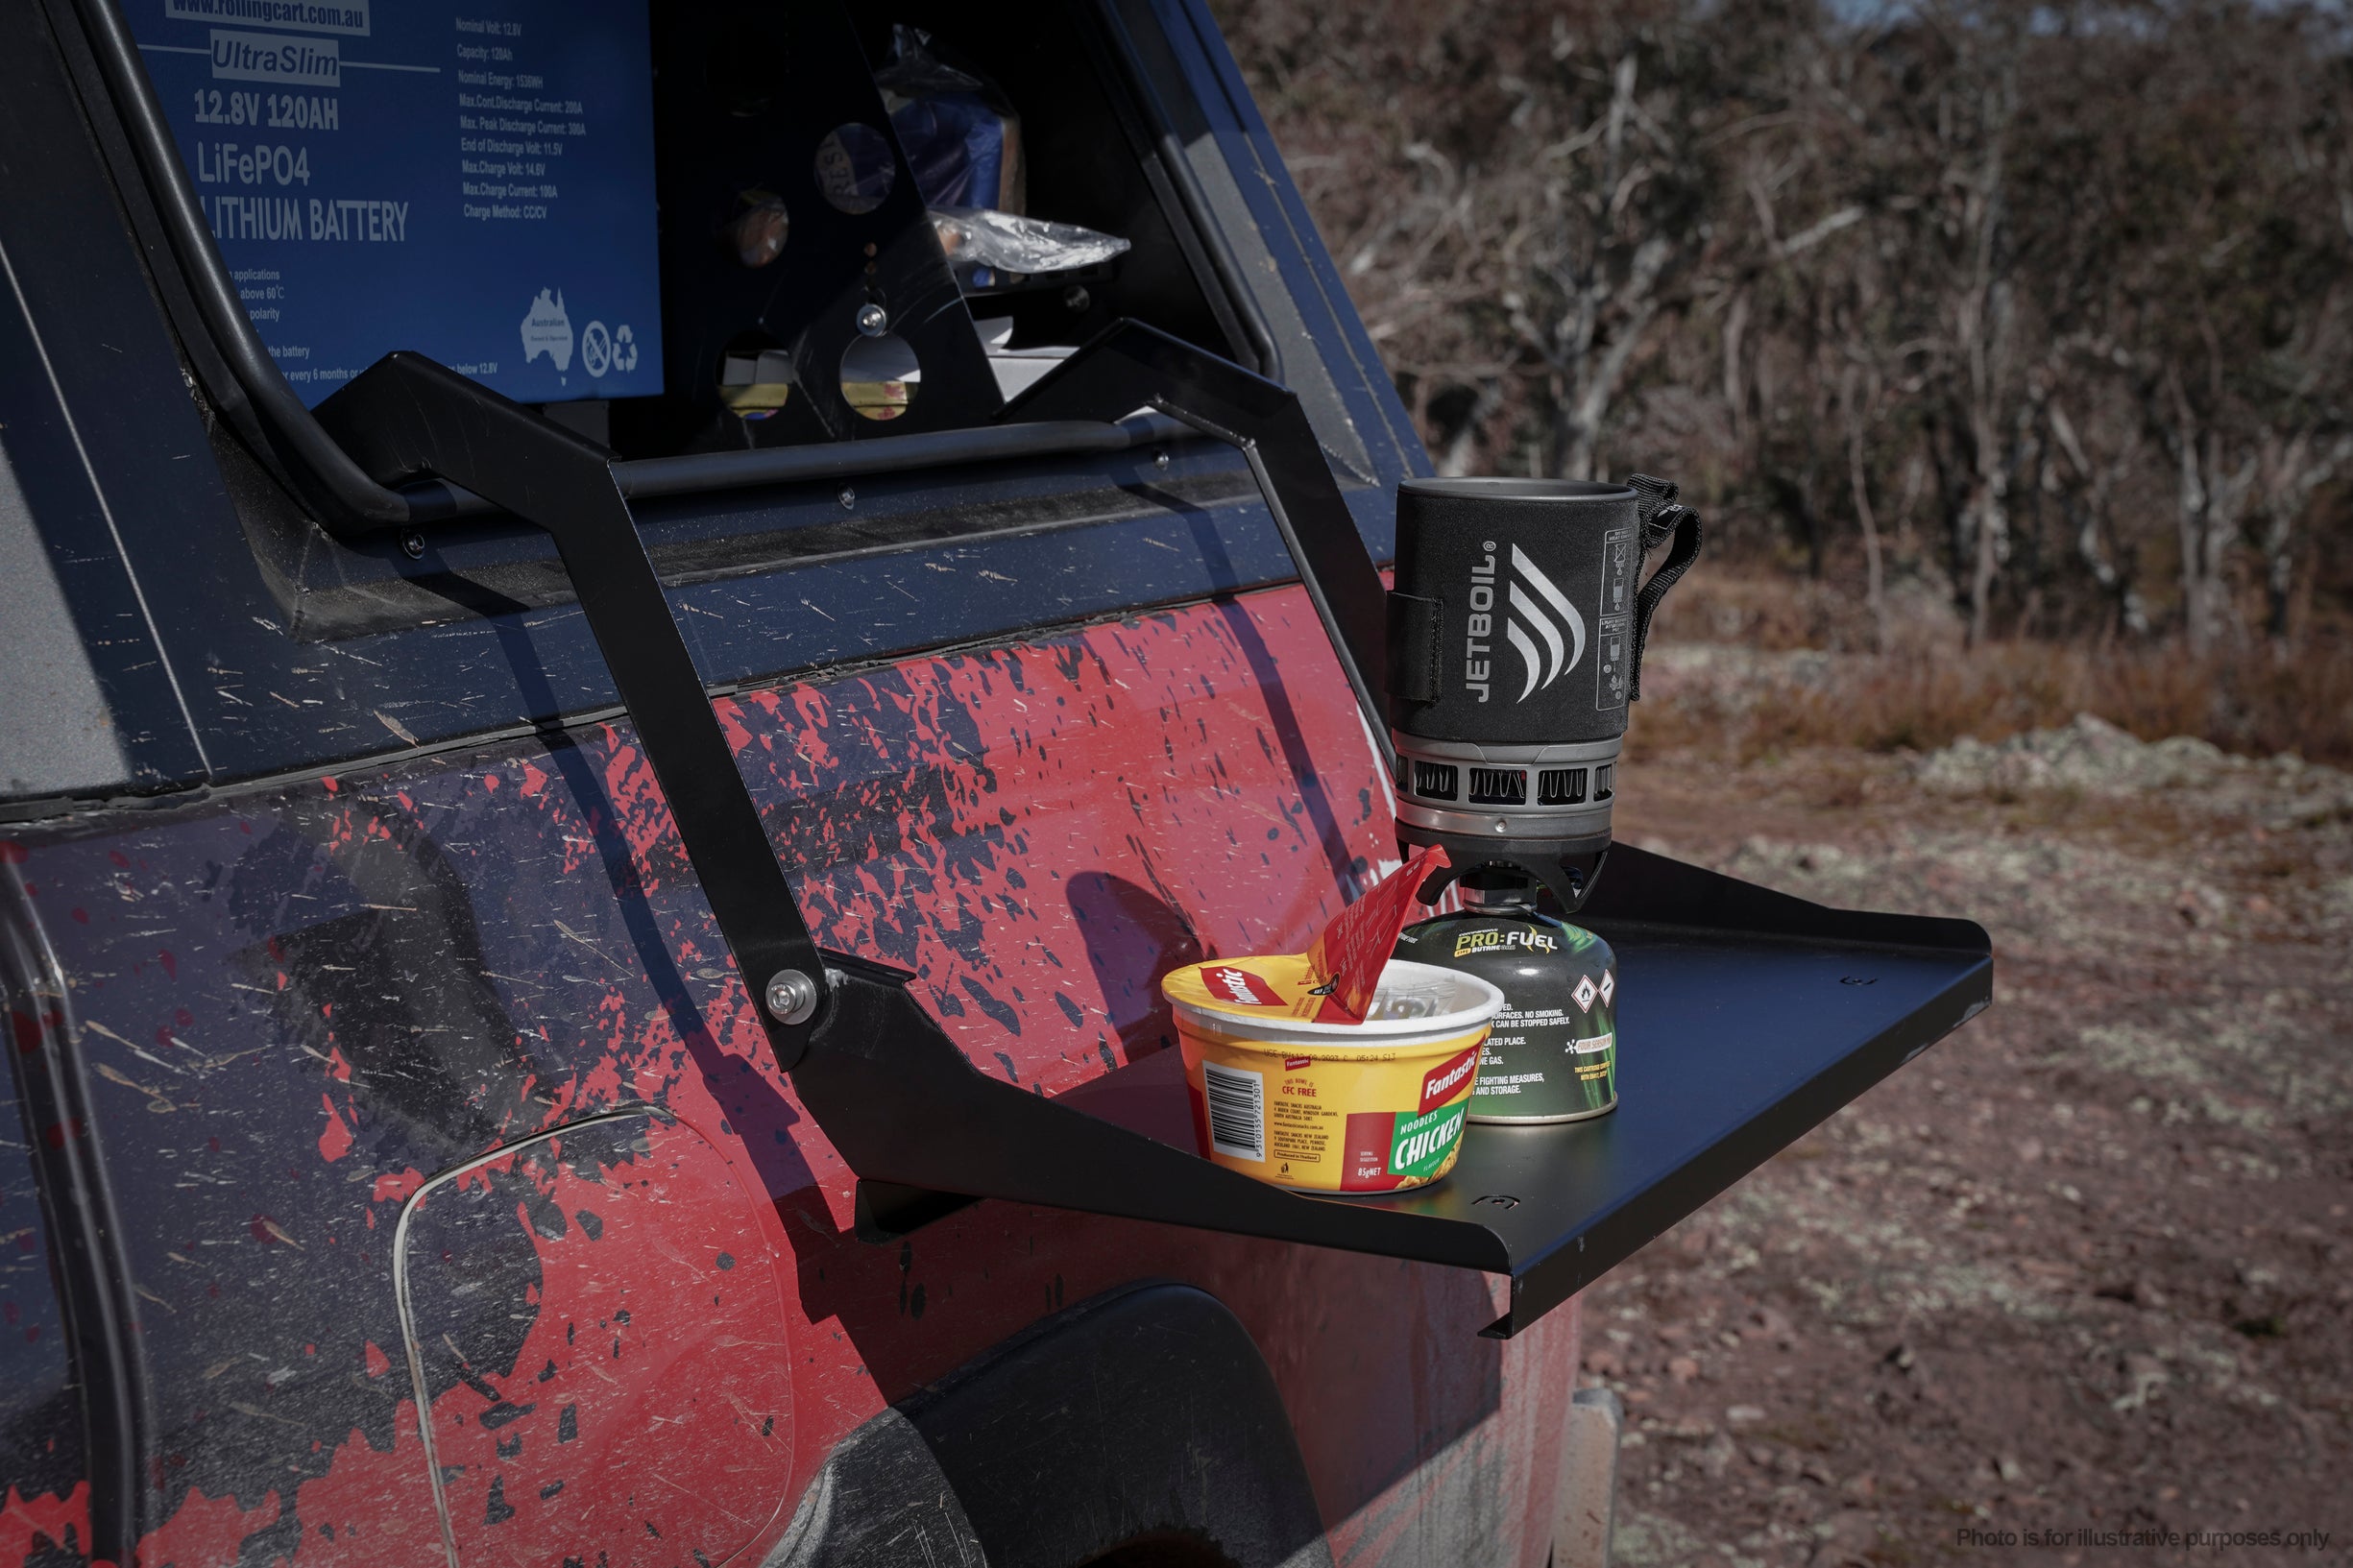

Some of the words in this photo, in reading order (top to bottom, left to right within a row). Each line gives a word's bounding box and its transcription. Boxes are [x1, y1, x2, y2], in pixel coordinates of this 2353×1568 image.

[174, 0, 363, 28] www.rollingcart.com.au
[455, 16, 485, 34] Nominal
[486, 20, 501, 36] Volt:
[503, 22, 522, 36] 12.8V
[212, 39, 337, 76] UltraSlim
[456, 43, 490, 61] Capacity:
[492, 47, 513, 60] 120Ah
[458, 69, 487, 85] Nominal
[488, 72, 515, 89] Energy:
[517, 75, 544, 88] 1536WH
[194, 88, 259, 126] 12.8V
[267, 93, 338, 131] 120AH
[534, 98, 563, 113] Current:
[460, 115, 478, 129] Max.
[479, 116, 498, 131] Peak
[499, 117, 536, 135] Discharge
[538, 120, 567, 134] Current:
[461, 137, 476, 151] End
[477, 138, 486, 152] of
[487, 138, 524, 157] Discharge
[525, 141, 542, 155] Volt:
[544, 142, 563, 155] 11.5V
[198, 141, 310, 186] LiFePO4
[507, 161, 523, 175] Volt:
[525, 162, 546, 176] 14.6V
[508, 183, 538, 198] Current:
[540, 184, 558, 198] 100A
[464, 204, 491, 221] Charge
[492, 205, 522, 218] Method:
[523, 205, 546, 219] CC/CV
[309, 199, 408, 242] BATTERY
[234, 269, 280, 282] applications
[240, 287, 265, 300] above
[250, 307, 280, 322] polarity
[531, 317, 566, 327] Australian
[268, 346, 281, 357] the
[282, 346, 310, 359] battery
[290, 371, 311, 383] every
[313, 369, 319, 379] 6
[320, 367, 349, 380] months
[456, 363, 478, 374] below
[479, 361, 497, 374] 12.8V
[1471, 944, 1500, 953] BUTANE
[1535, 1009, 1564, 1019] SMOKING.
[1495, 1020, 1510, 1028] CAN
[1519, 1018, 1548, 1027] STOPPED
[1549, 1016, 1570, 1026] SAFELY.
[1504, 1037, 1527, 1046] PLACE.
[1264, 1049, 1277, 1058] USE
[1489, 1056, 1504, 1065] GAS.
[1479, 1075, 1509, 1086] FIGHTING
[1509, 1073, 1545, 1084] MEASURES,
[1282, 1086, 1295, 1095] CFC
[1298, 1087, 1317, 1097] FREE
[1476, 1087, 1490, 1096] AND
[1491, 1085, 1521, 1095] STORAGE.
[1400, 1110, 1438, 1135] NOODLES
[1395, 1106, 1465, 1170] CHICKEN
[1357, 1167, 1382, 1179] 85gNET
